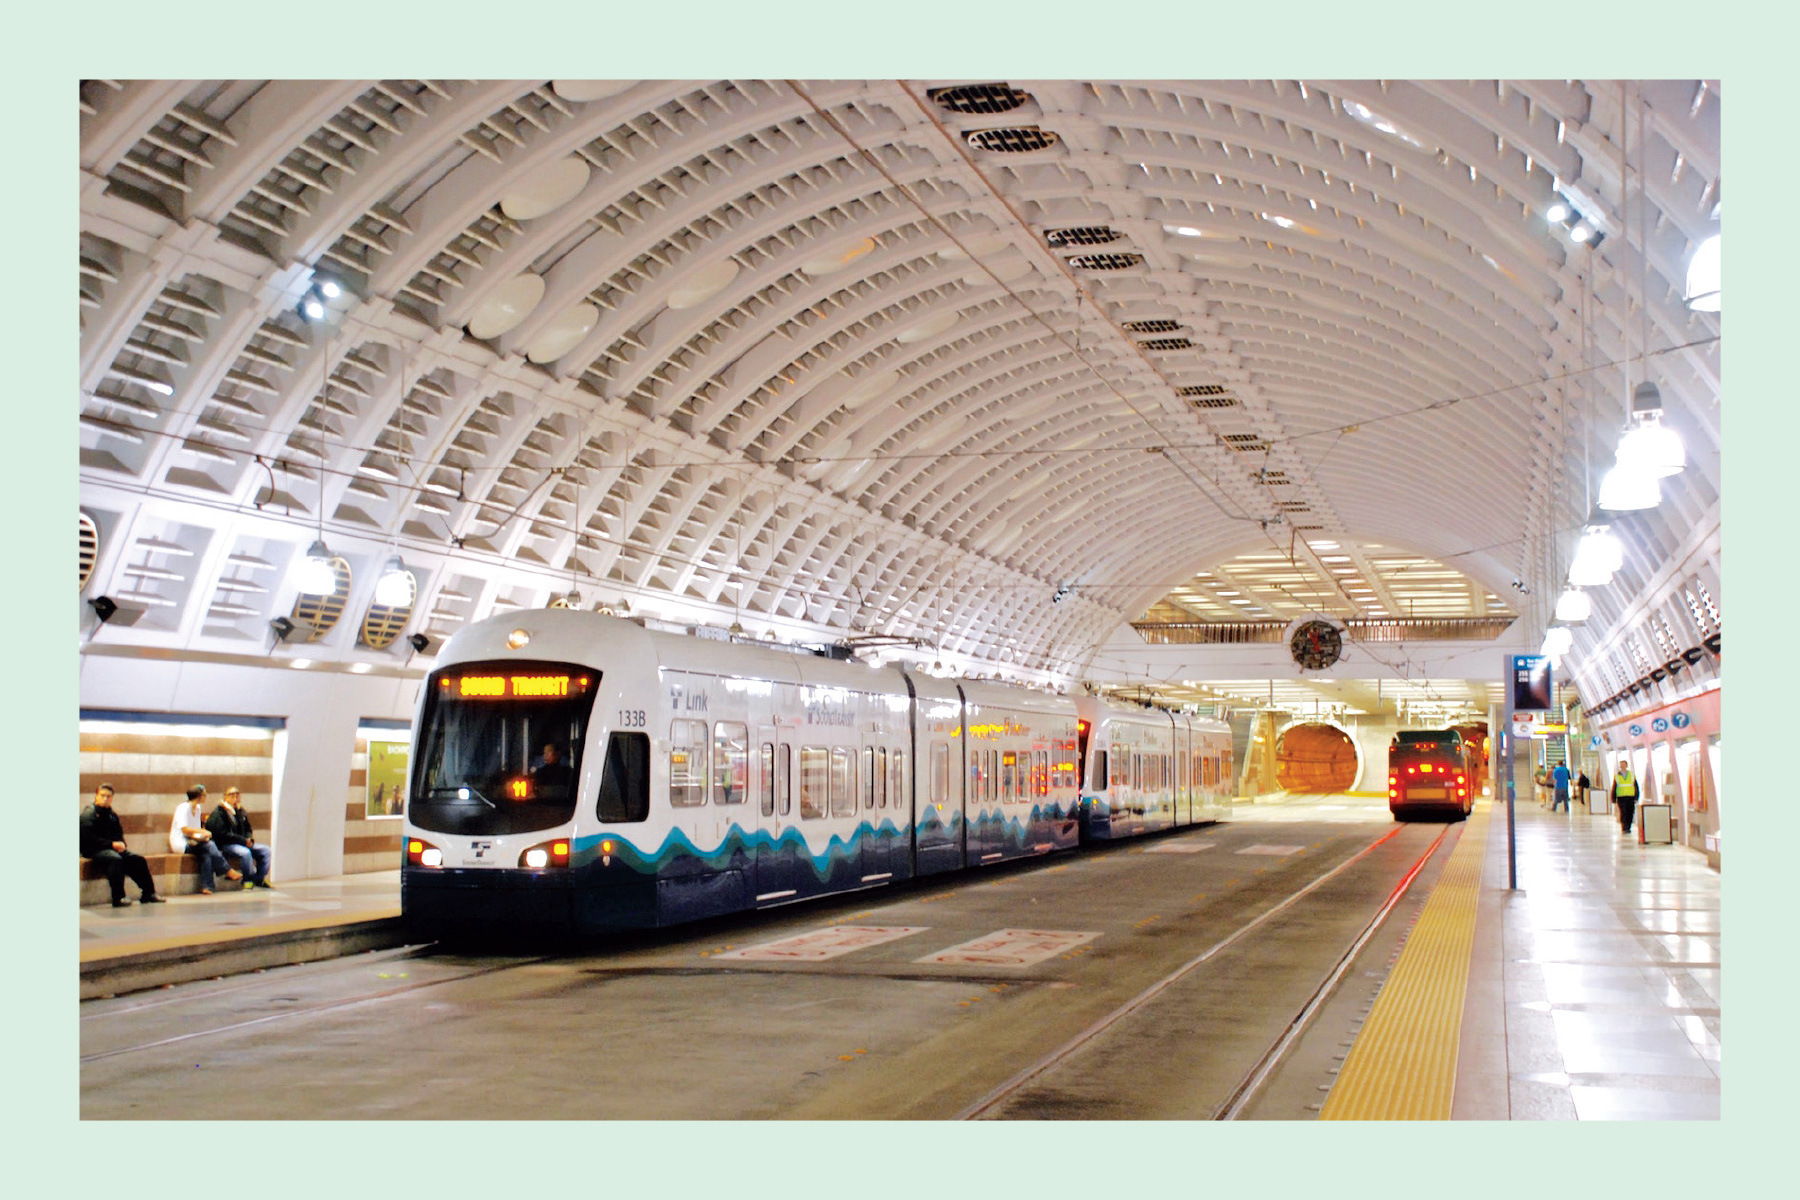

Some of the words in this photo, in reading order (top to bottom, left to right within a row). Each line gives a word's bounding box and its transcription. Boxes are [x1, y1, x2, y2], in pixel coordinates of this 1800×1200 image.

[460, 676, 506, 696] SOUND
[510, 676, 570, 696] TRANSIT
[686, 688, 708, 712] Link
[618, 710, 646, 727] 133B
[512, 780, 527, 798] 11
